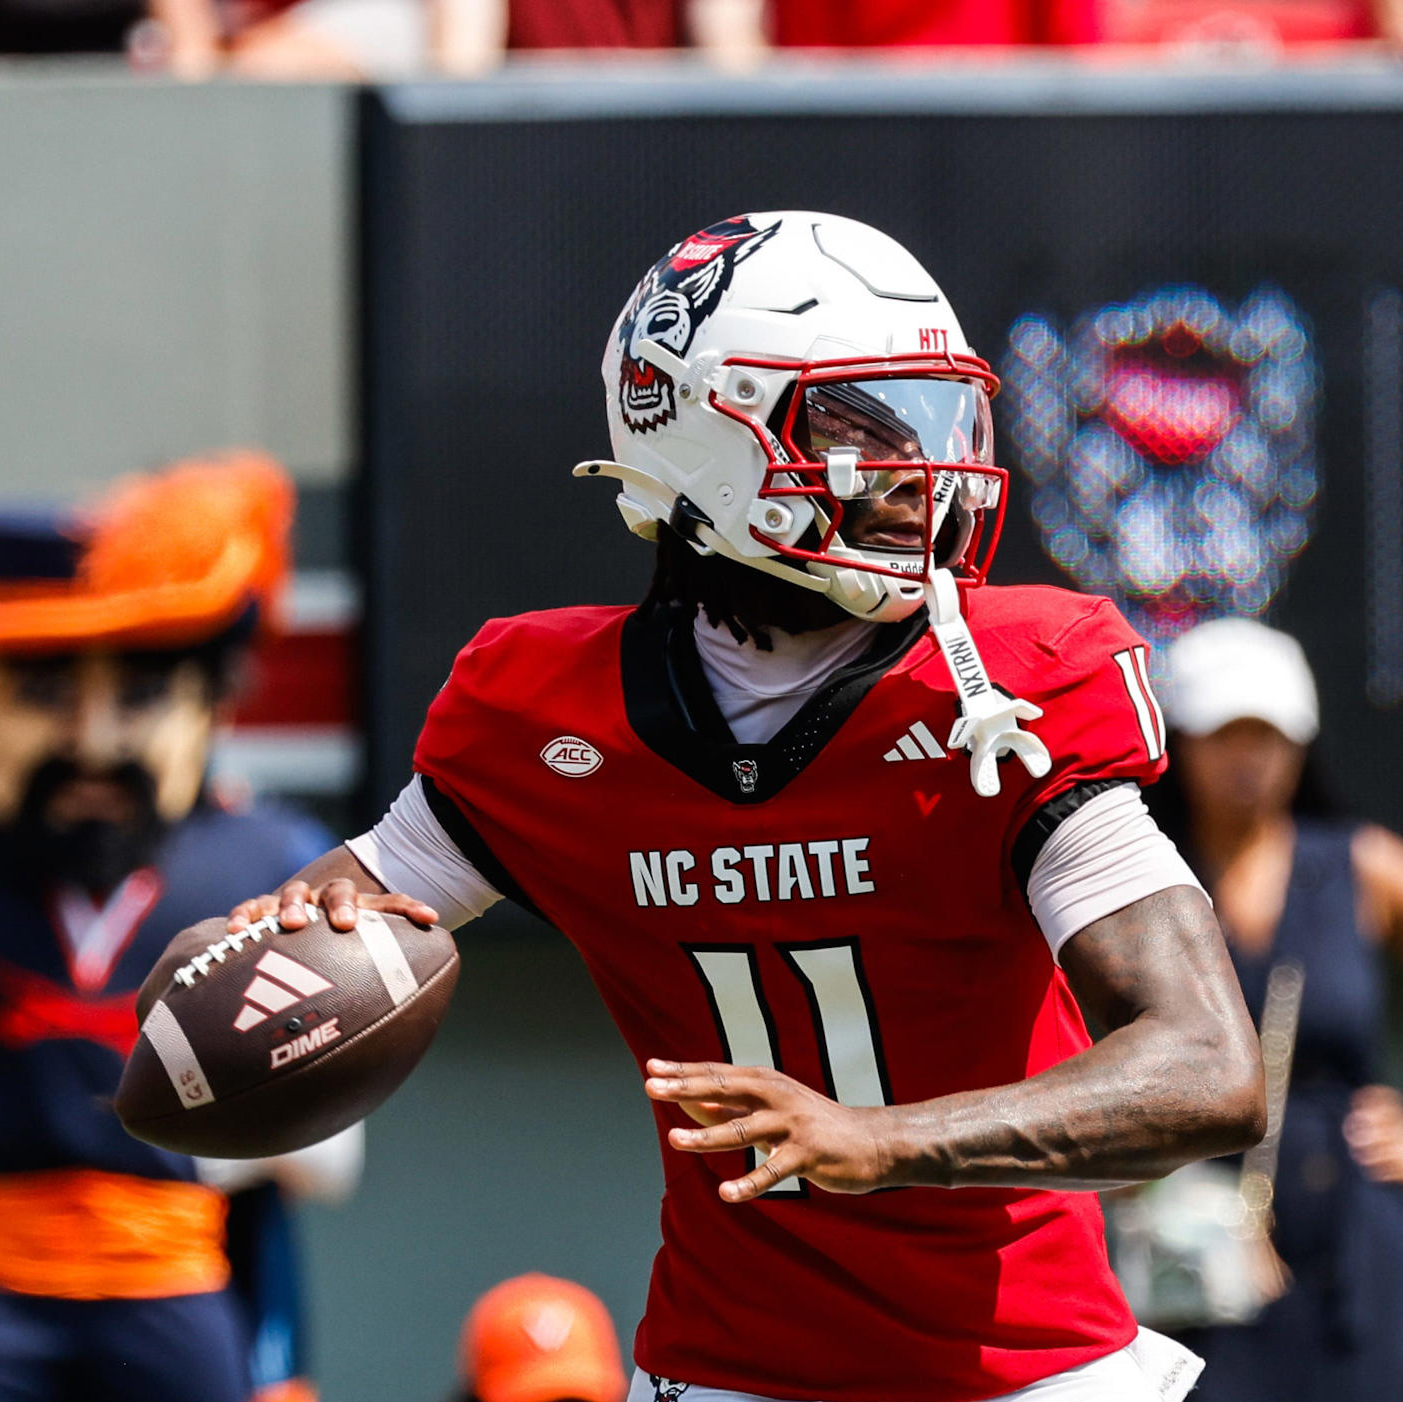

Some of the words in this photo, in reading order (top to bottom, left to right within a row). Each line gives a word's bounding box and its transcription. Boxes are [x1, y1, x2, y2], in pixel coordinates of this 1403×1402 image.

[919, 328, 948, 351] HTT
[1111, 645, 1166, 762] 11
[552, 747, 592, 761] ACC
[628, 849, 700, 907] NC
[709, 836, 876, 906] STATE
[270, 1017, 342, 1069] DIME
[679, 936, 895, 1199] 11
